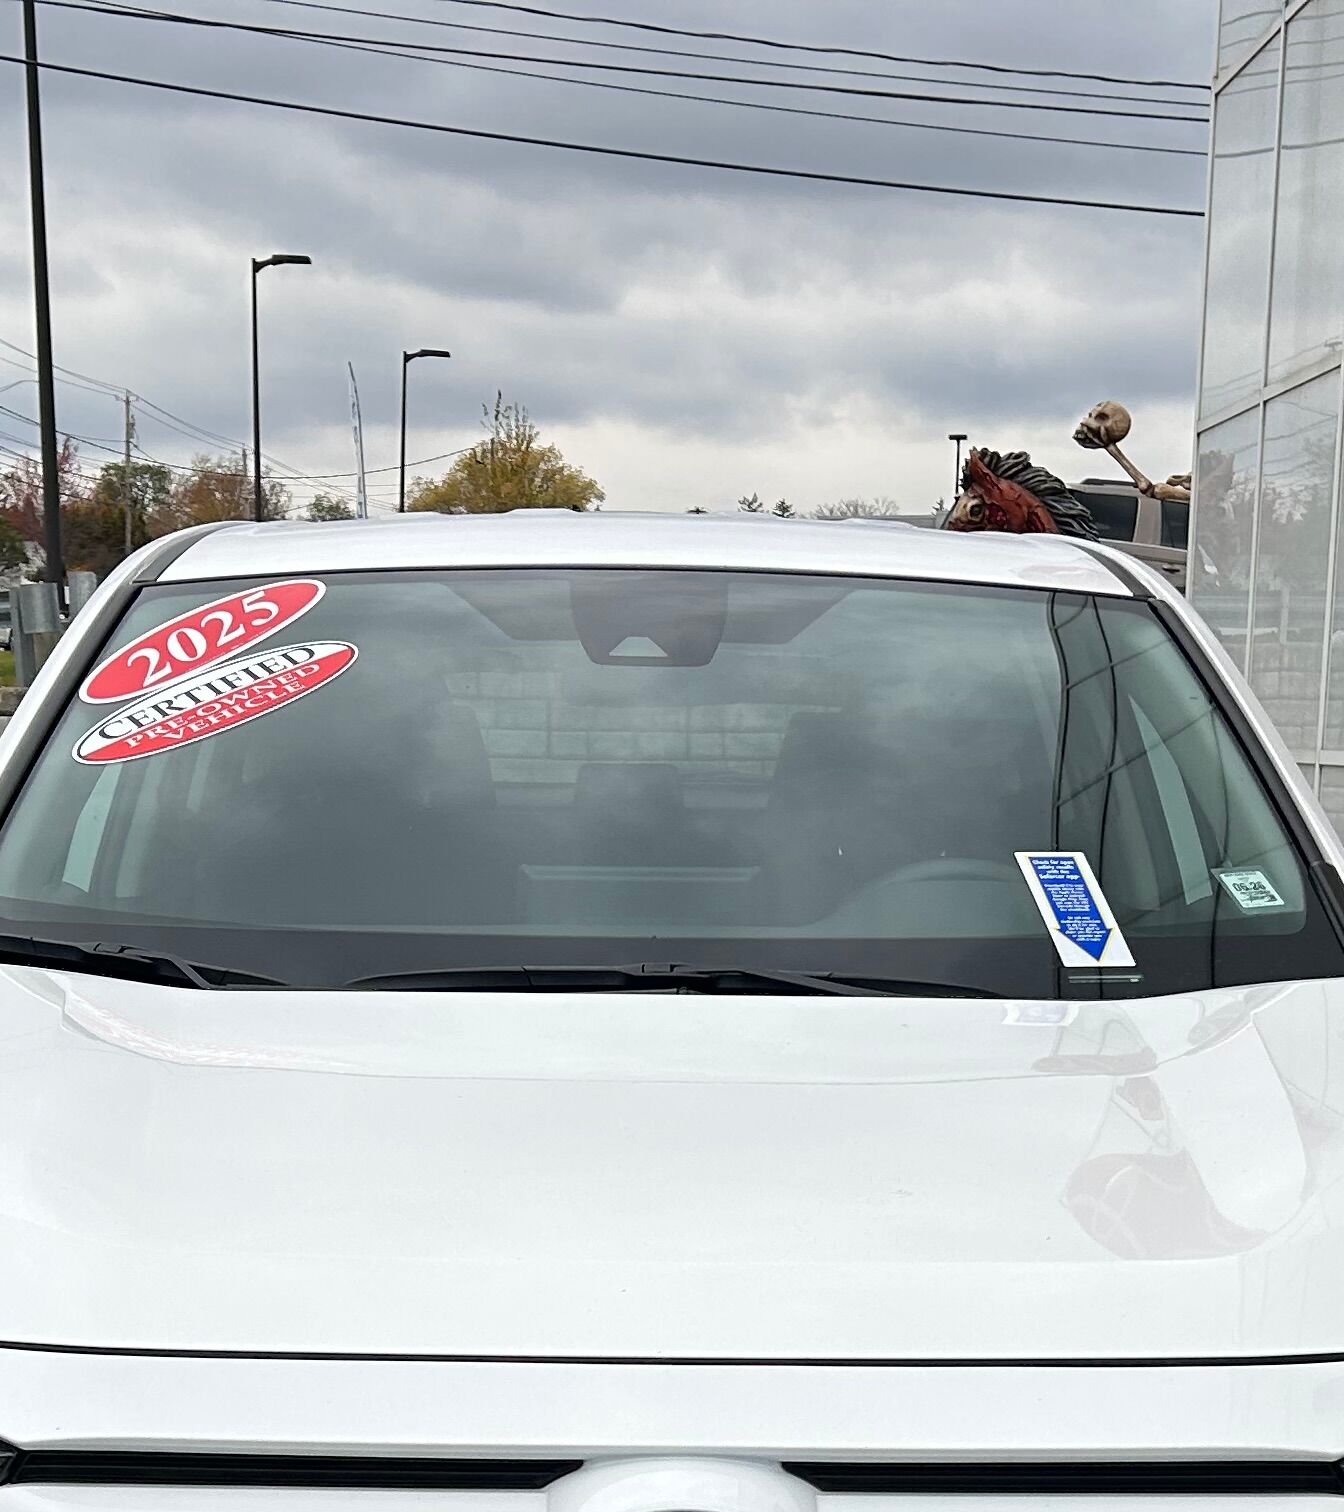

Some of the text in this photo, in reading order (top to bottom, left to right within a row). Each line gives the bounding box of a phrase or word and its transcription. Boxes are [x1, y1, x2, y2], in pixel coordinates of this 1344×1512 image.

[127, 590, 280, 688] 2025
[99, 647, 316, 740] CERTIFIED
[123, 663, 320, 748] PRE-OWNED
[163, 680, 306, 740] VEHICLE
